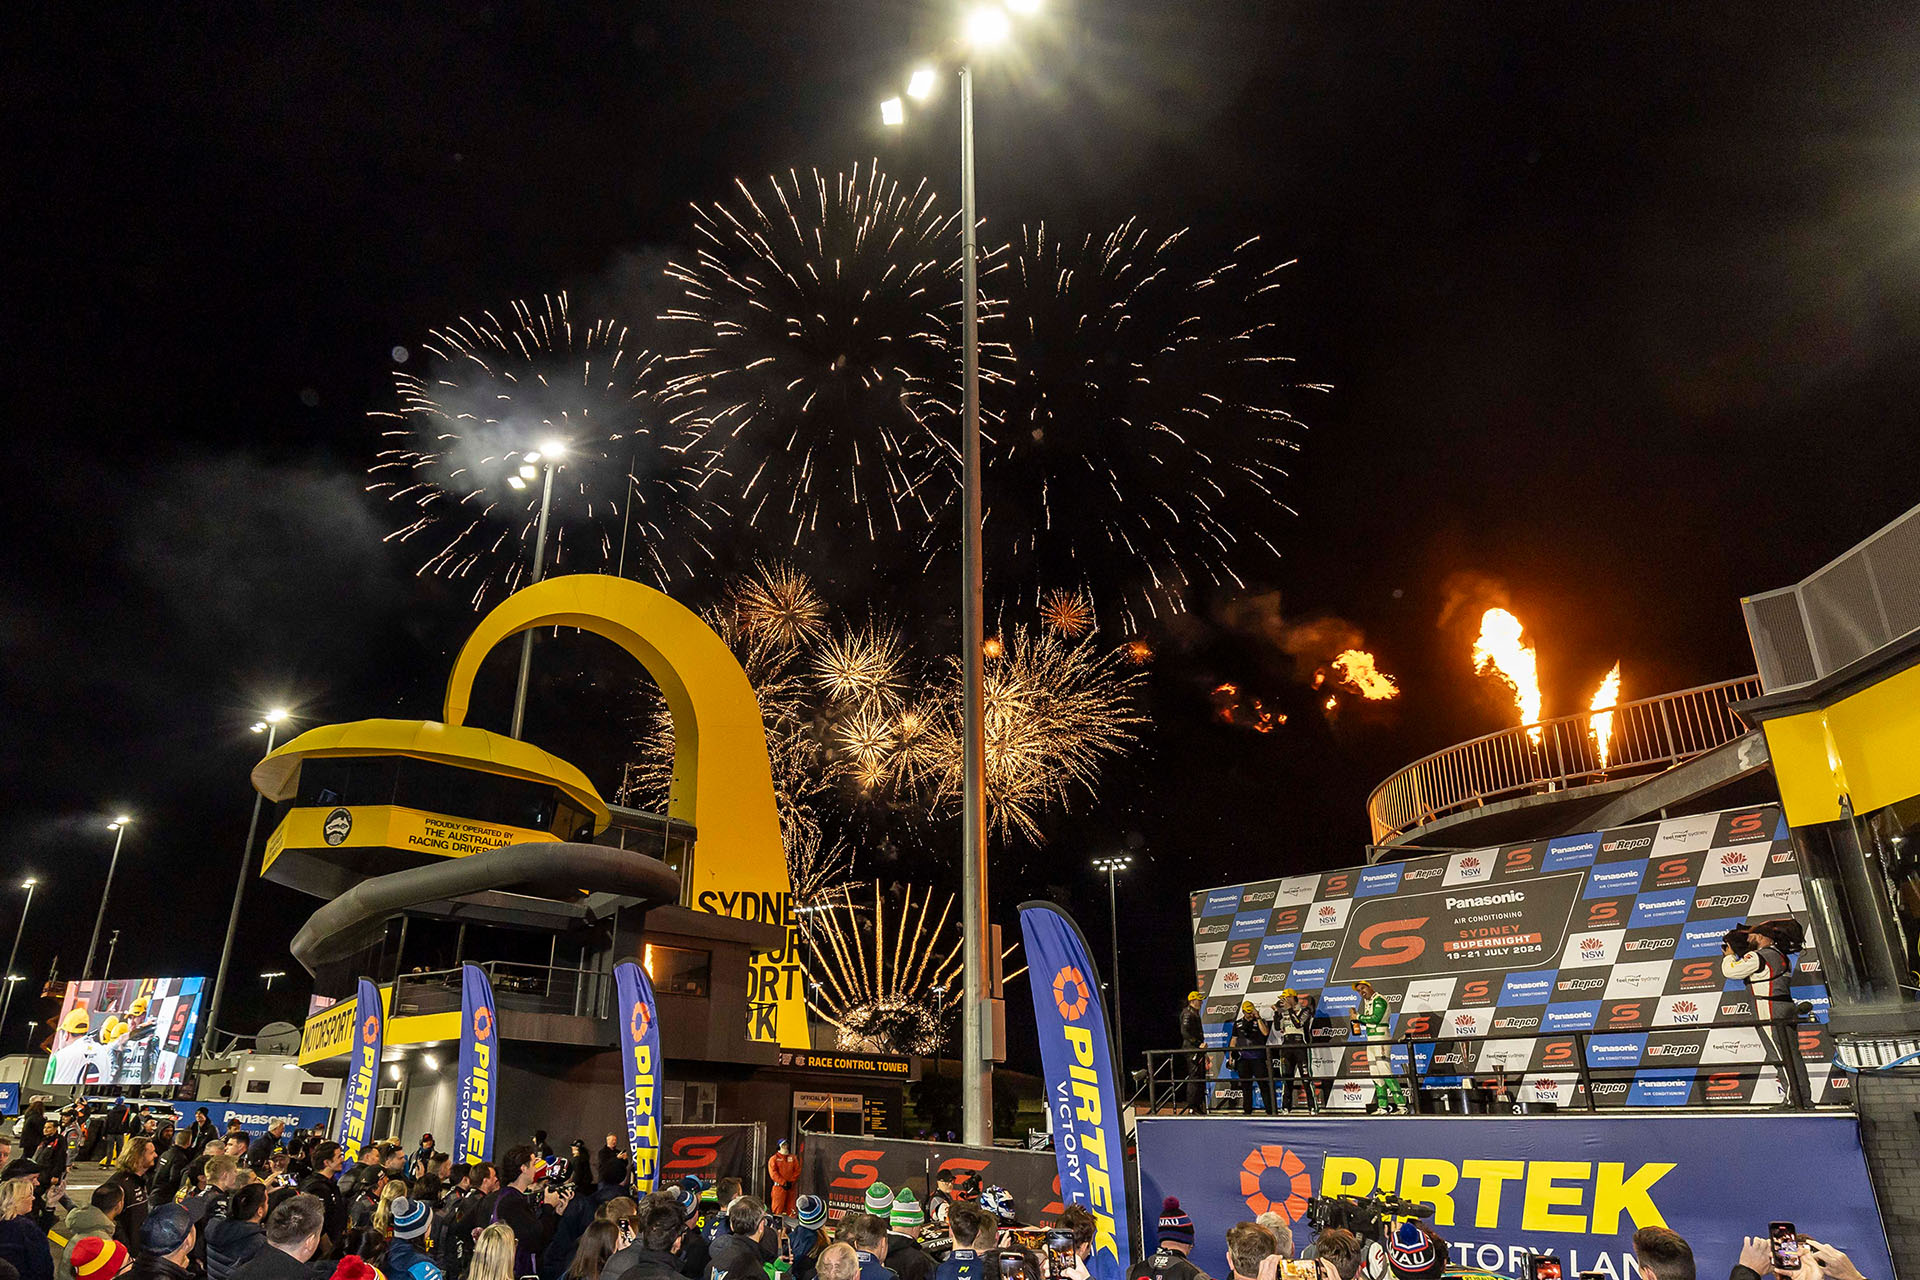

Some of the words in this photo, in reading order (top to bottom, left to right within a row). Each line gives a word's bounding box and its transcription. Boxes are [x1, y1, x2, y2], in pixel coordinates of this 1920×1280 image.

[425, 818, 460, 830] PROUDLY
[462, 824, 500, 838] OPERATED
[503, 831, 514, 840] BY
[425, 827, 445, 838] THE
[448, 832, 511, 848] AUSTRALIAN
[408, 835, 449, 850] RACING
[451, 842, 499, 856] DRIVER
[1551, 843, 1594, 855] Panasonic
[1616, 838, 1651, 850] Repco
[1416, 868, 1443, 880] Repco
[1461, 868, 1481, 877] NSW
[1722, 864, 1749, 875] NSW
[1363, 872, 1398, 882] Panasonic
[1594, 870, 1639, 881] Panasonic
[1209, 894, 1238, 904] Panasonic
[1252, 891, 1275, 902] Repco
[1446, 890, 1525, 910] Panasonic
[1712, 894, 1748, 906] Repco
[698, 890, 798, 926] SYDNE
[1639, 898, 1686, 910] Panasonic
[1236, 918, 1265, 926] Panasonic
[1319, 916, 1337, 924] NSW
[1454, 917, 1467, 925] AIR
[1468, 911, 1523, 923] CONDITIONING
[1460, 924, 1520, 939] SYDNEY
[1264, 942, 1294, 950] Panasonic
[1310, 940, 1335, 951] Repco
[1453, 935, 1531, 950] SUPERNIGHT
[1640, 938, 1674, 951] Repco
[1484, 948, 1509, 957] JULY
[1513, 944, 1542, 954] 2024
[1581, 950, 1604, 959] NSW
[1293, 967, 1326, 976] Panasonic
[1262, 973, 1286, 983] Repco
[1224, 982, 1240, 990] NSW
[1507, 981, 1549, 990] Panasonic
[1571, 979, 1604, 989] Repco
[1323, 994, 1357, 1003] Panasonic
[1215, 1005, 1238, 1014] Repco
[1549, 1011, 1592, 1020] Panasonic
[1673, 1014, 1699, 1023] NSW
[1507, 1018, 1537, 1028] Repco
[302, 1012, 353, 1054] MOTORSPORT
[1321, 1027, 1348, 1037] Repco
[1455, 1026, 1476, 1034] NSW
[1592, 1044, 1639, 1053] Panasonic
[1663, 1045, 1698, 1055] Repco
[1446, 1054, 1475, 1064] Repo
[808, 1056, 833, 1068] RACE
[834, 1058, 875, 1071] CONTROL
[877, 1061, 908, 1073] TOWER
[121, 1069, 141, 1078] PTUS
[1638, 1078, 1686, 1087] Panasonic
[1592, 1083, 1626, 1093] Repco
[1224, 1089, 1243, 1099] Repc
[1536, 1091, 1559, 1099] NSW
[344, 1073, 358, 1126] VICTORY
[344, 1045, 375, 1163] PIRTEK
[460, 1076, 472, 1139] VICTORY
[1512, 1105, 1522, 1115] 3
[223, 1110, 300, 1127] Panasonic
[1056, 1080, 1082, 1184] VICTORY
[1063, 1025, 1119, 1265] PIRTEK
[458, 1143, 467, 1162] LA
[828, 1193, 865, 1203] SUPERCA
[1321, 1157, 1678, 1235] PIRTEK
[828, 1201, 865, 1210] CHAMPIONS
[1571, 1249, 1642, 1280] LAN
